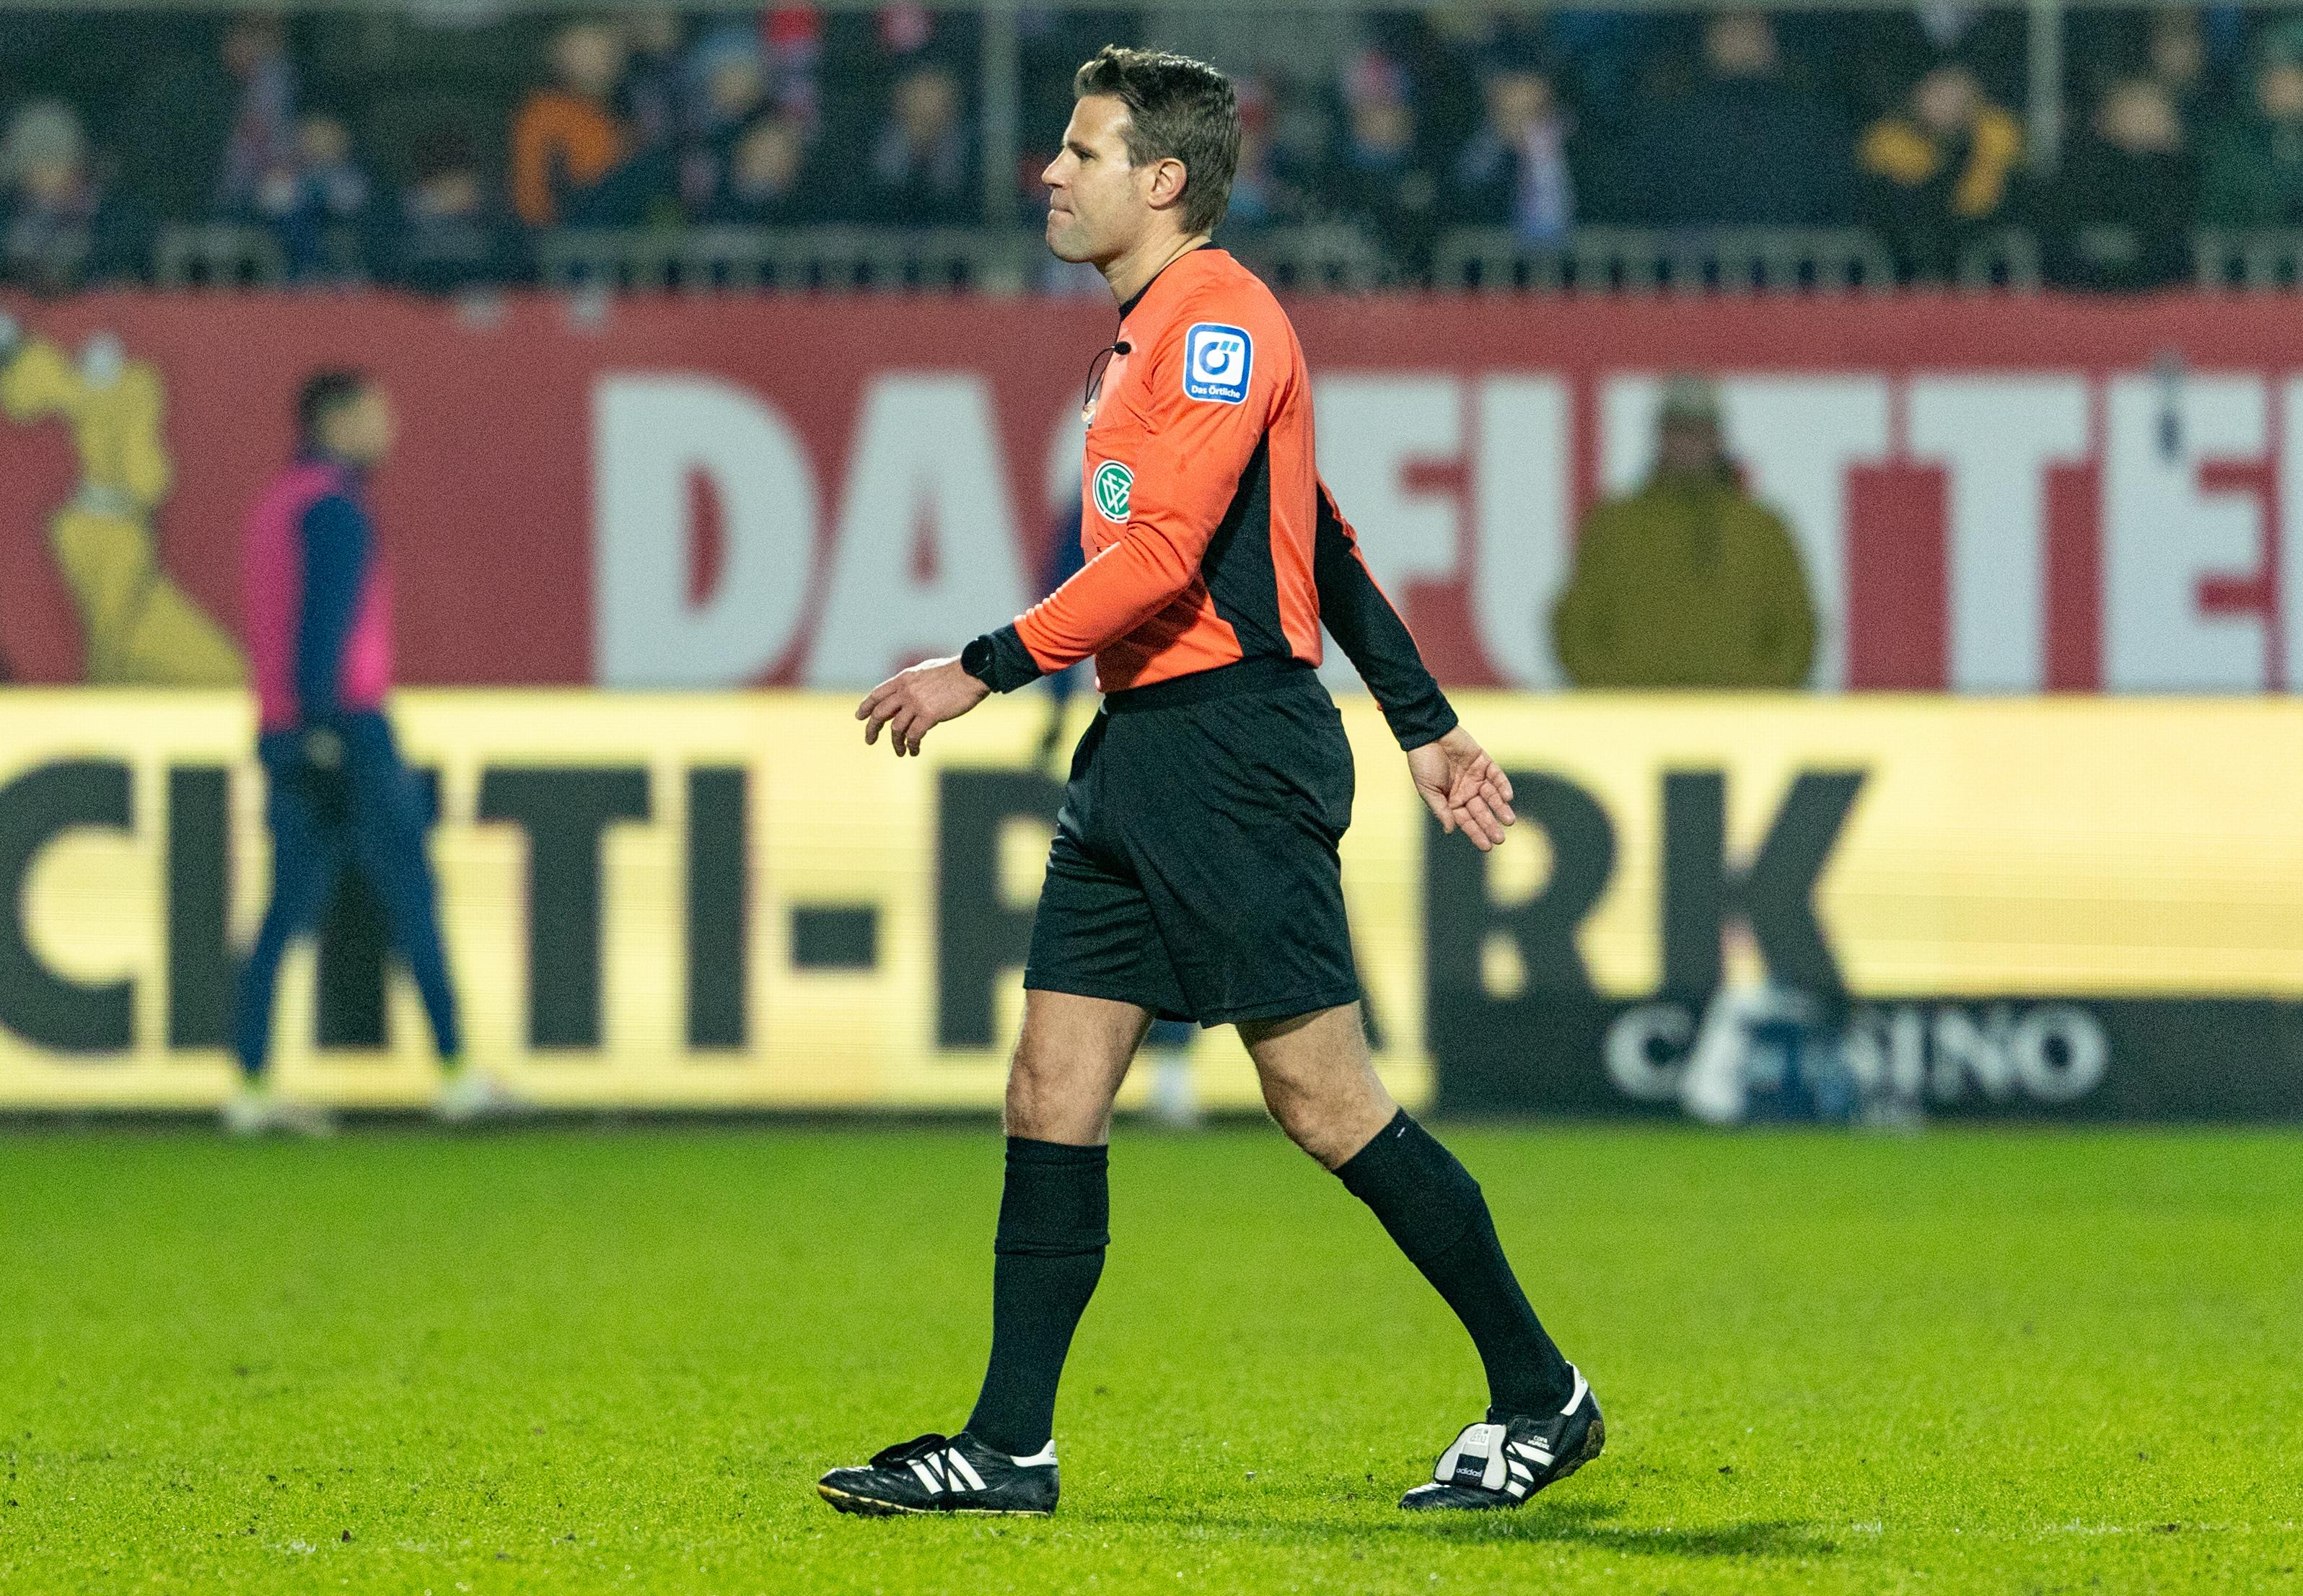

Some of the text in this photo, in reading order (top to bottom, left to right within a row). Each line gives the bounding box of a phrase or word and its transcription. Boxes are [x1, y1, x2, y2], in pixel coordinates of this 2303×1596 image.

[1191, 385, 1241, 398] Das Örtliche
[588, 371, 2303, 690] DA FUTTE
[1456, 1467, 1483, 1478] adidas
